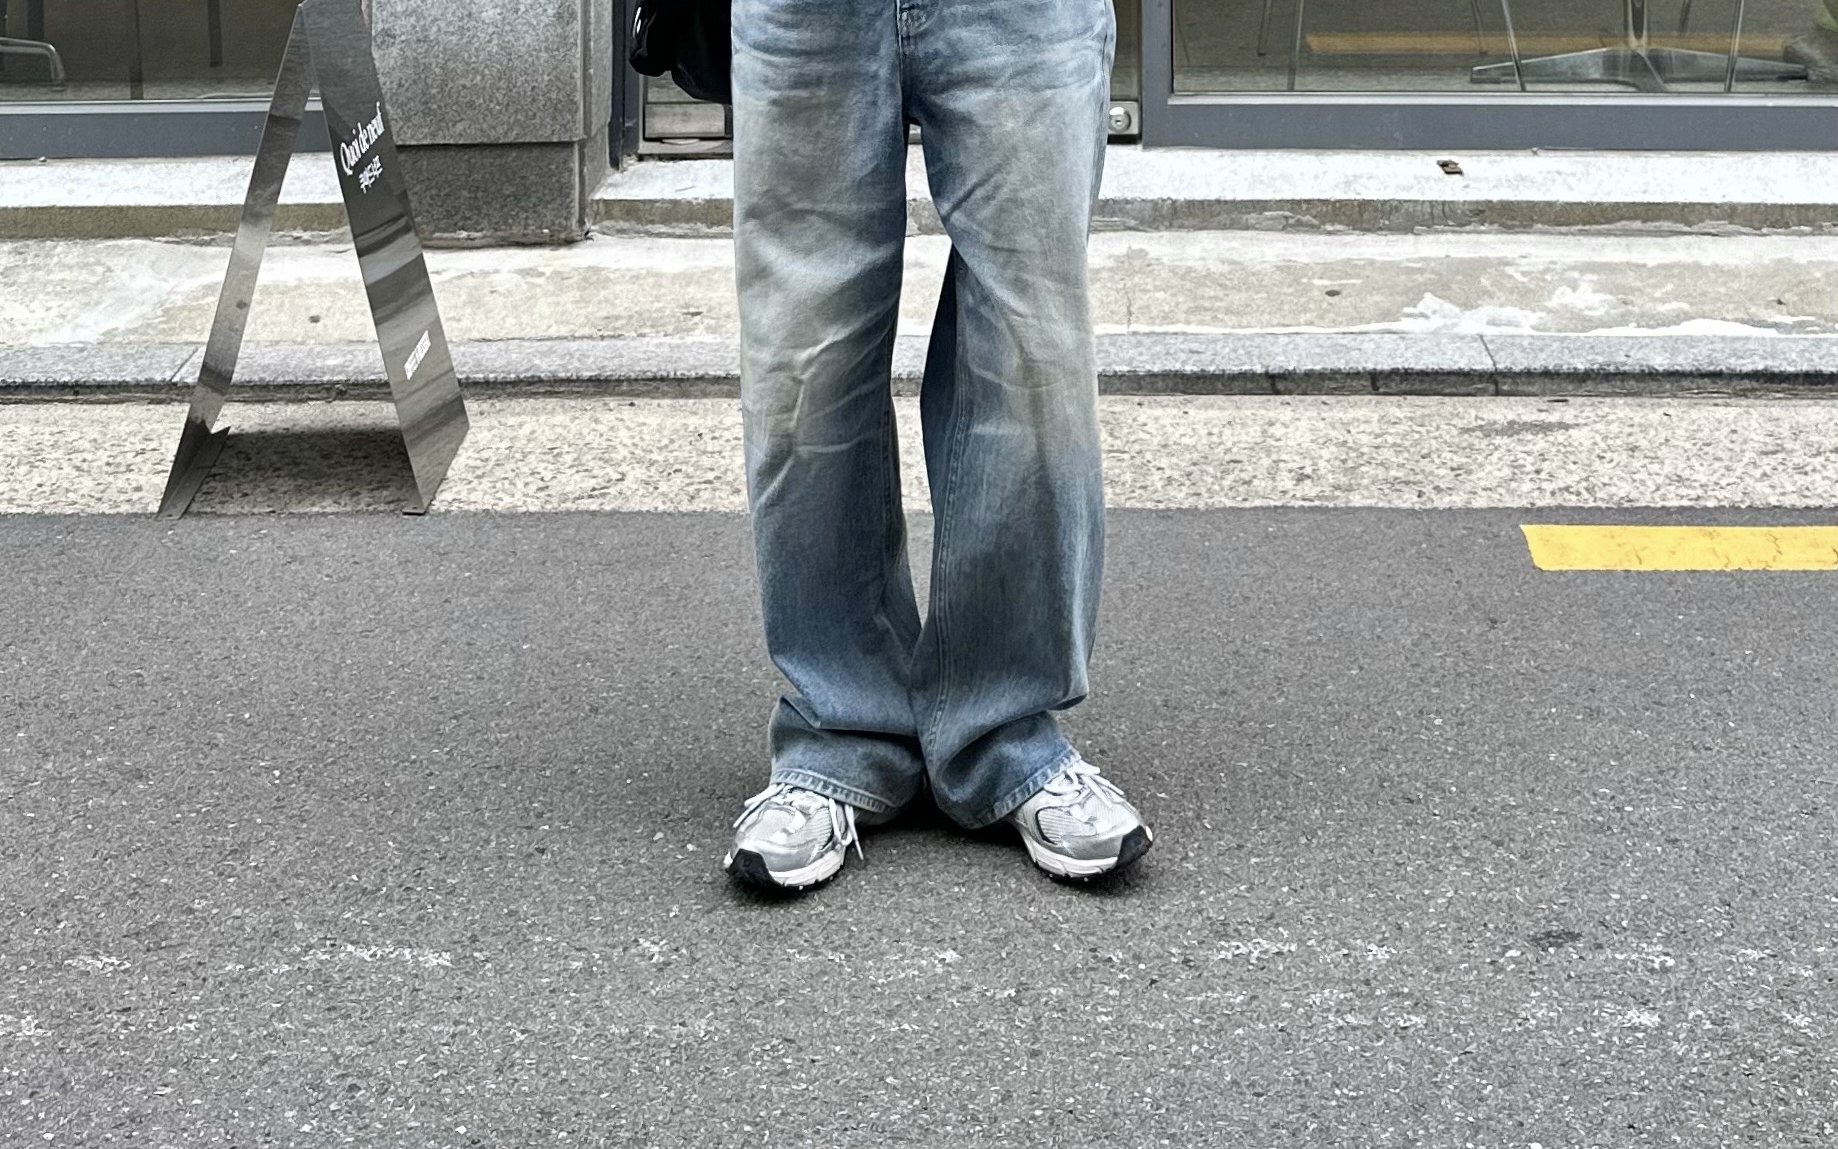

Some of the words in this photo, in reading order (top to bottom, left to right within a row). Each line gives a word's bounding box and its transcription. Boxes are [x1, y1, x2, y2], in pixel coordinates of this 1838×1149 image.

[340, 128, 362, 176] Quoi
[357, 122, 370, 154] de
[366, 101, 385, 145] neuf
